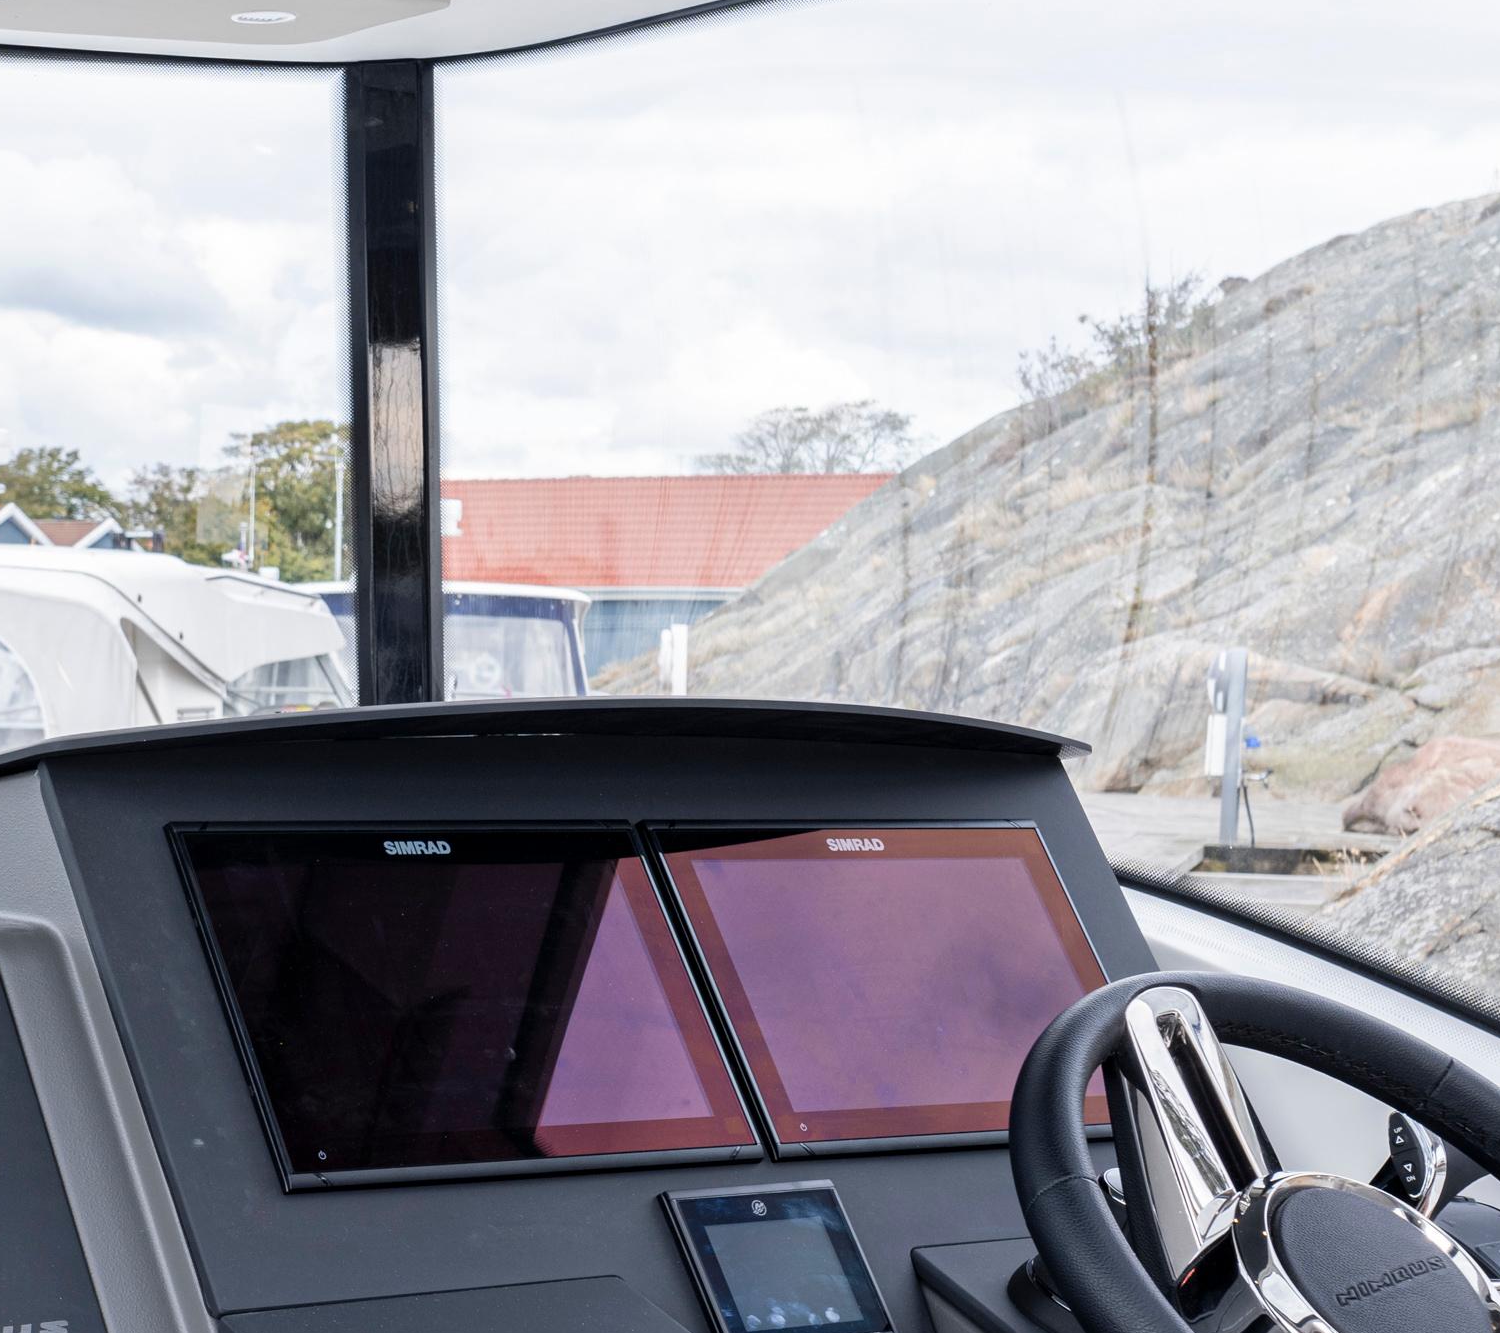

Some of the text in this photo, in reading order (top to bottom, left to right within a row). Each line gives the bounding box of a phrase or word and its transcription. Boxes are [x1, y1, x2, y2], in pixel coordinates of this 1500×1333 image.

[384, 840, 451, 856] SIMRAD
[826, 837, 885, 853] SIMRAD
[1336, 1256, 1447, 1307] NIMBUS
